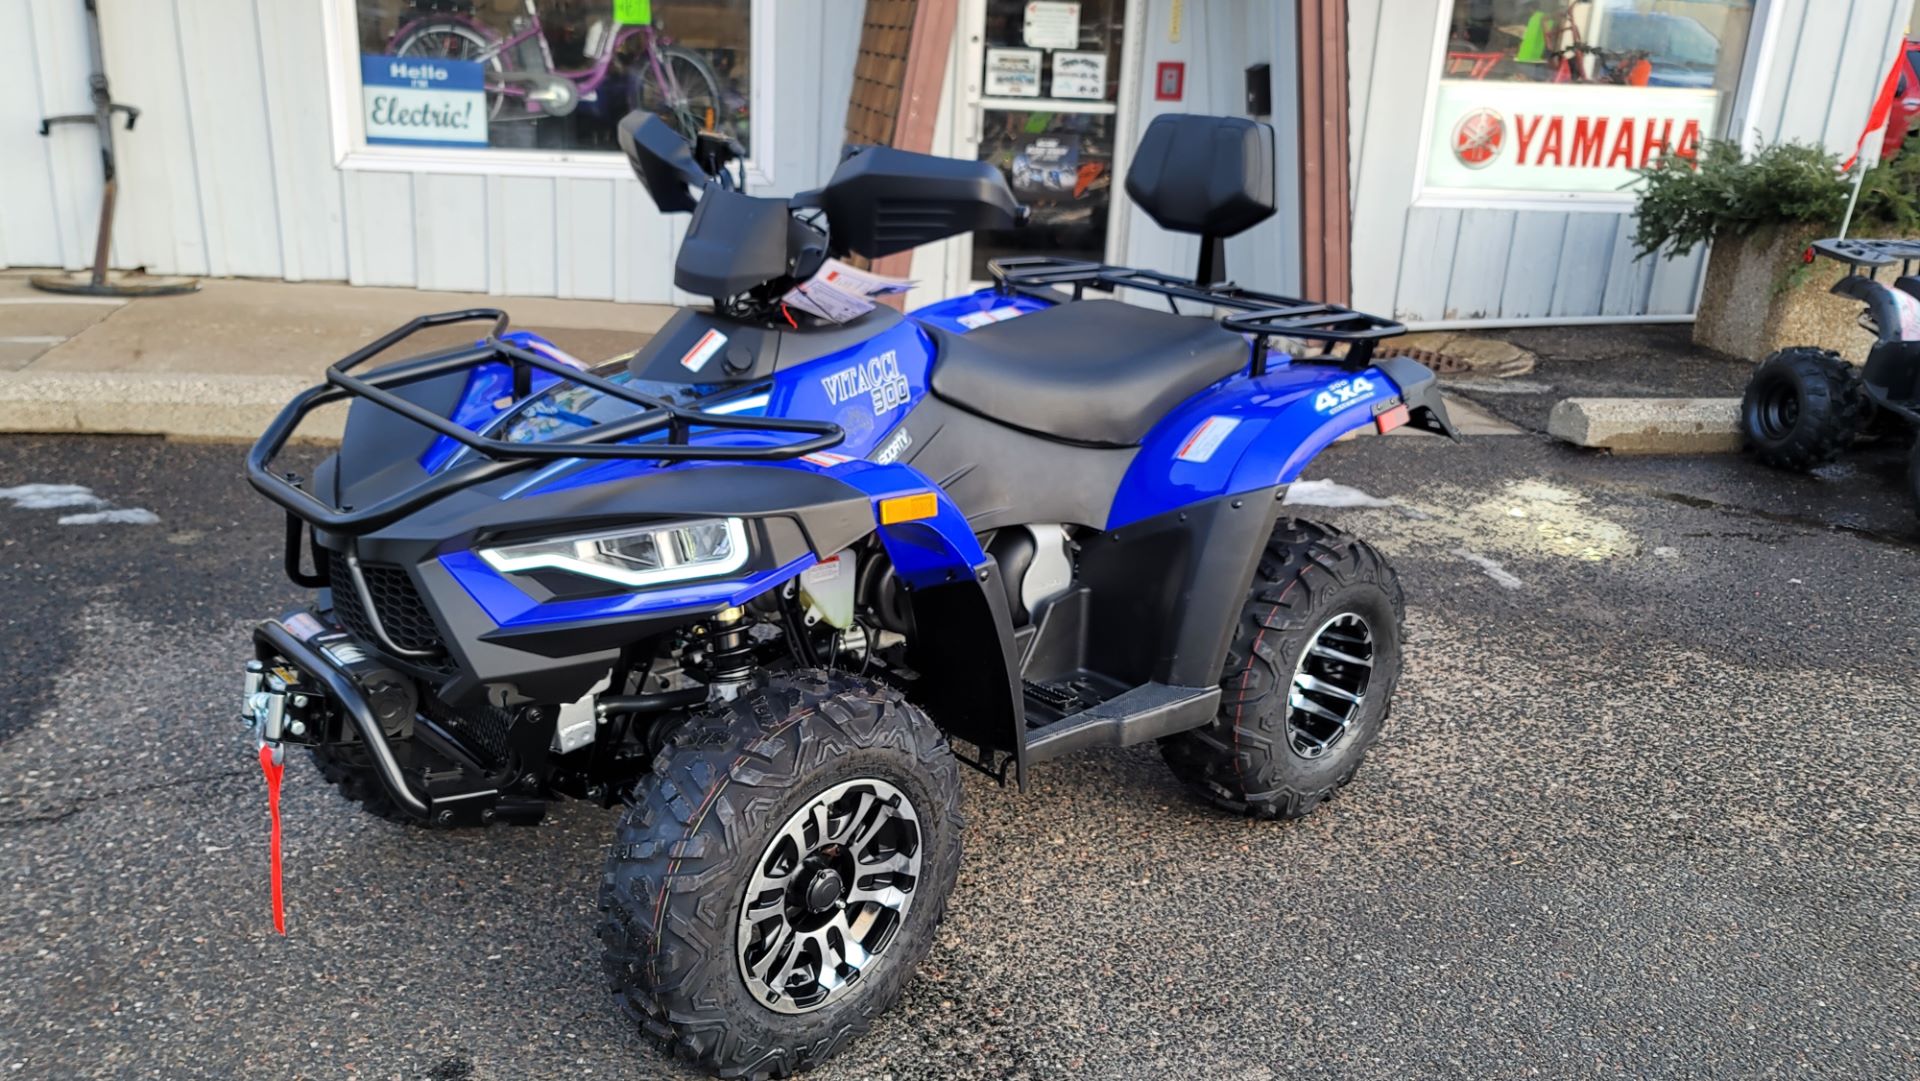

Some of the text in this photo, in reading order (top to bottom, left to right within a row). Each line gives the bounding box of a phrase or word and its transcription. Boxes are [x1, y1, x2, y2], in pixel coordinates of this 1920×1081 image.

[390, 63, 448, 80] Hello
[371, 96, 472, 129] Electric!
[1514, 115, 1699, 170] YAMAHA
[821, 350, 899, 405] VITACCI
[871, 375, 911, 416] 300
